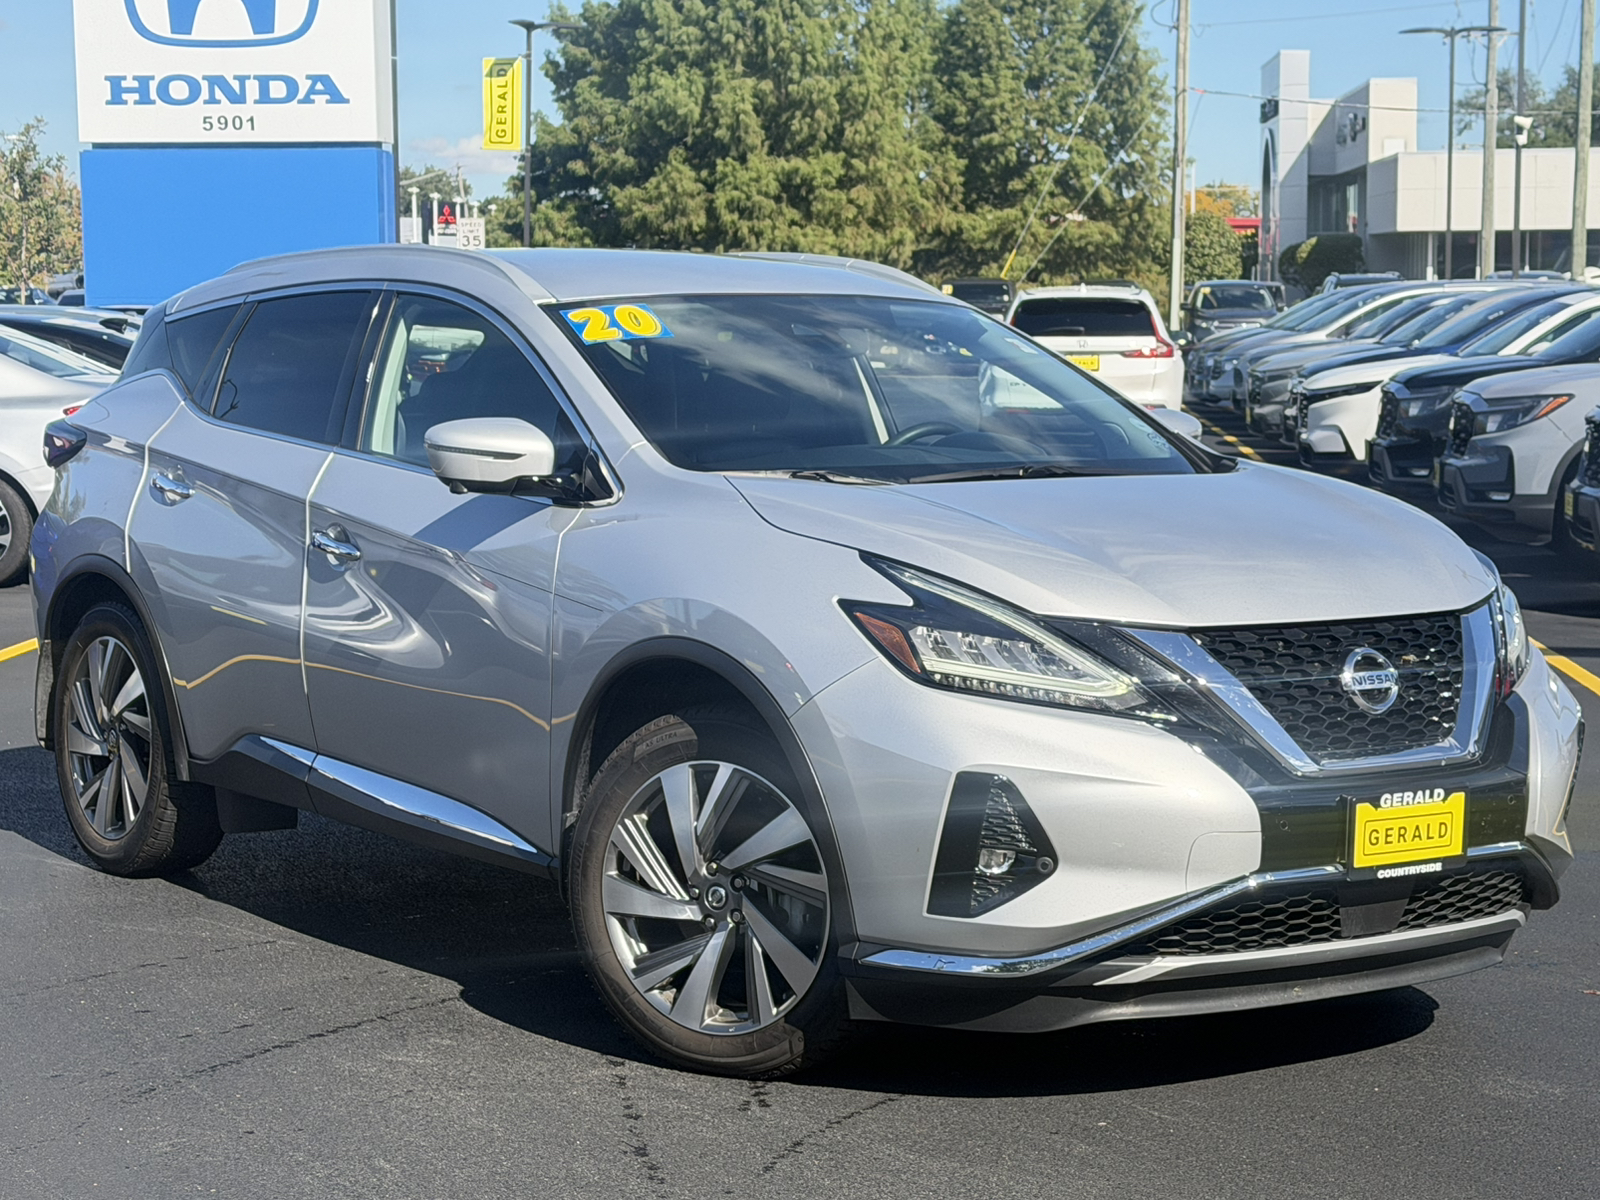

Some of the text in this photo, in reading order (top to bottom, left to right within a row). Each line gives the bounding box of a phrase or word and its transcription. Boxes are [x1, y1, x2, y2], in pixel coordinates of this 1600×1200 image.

[104, 74, 350, 106] HONDA
[496, 68, 508, 139] GERALD
[202, 115, 256, 132] 5901
[462, 235, 482, 248] 35
[567, 304, 663, 341] 20
[1352, 670, 1398, 688] NISSAN
[1379, 787, 1446, 809] GERALD
[1368, 821, 1449, 847] GERALD
[1377, 862, 1443, 880] COUNTRYSIDE
